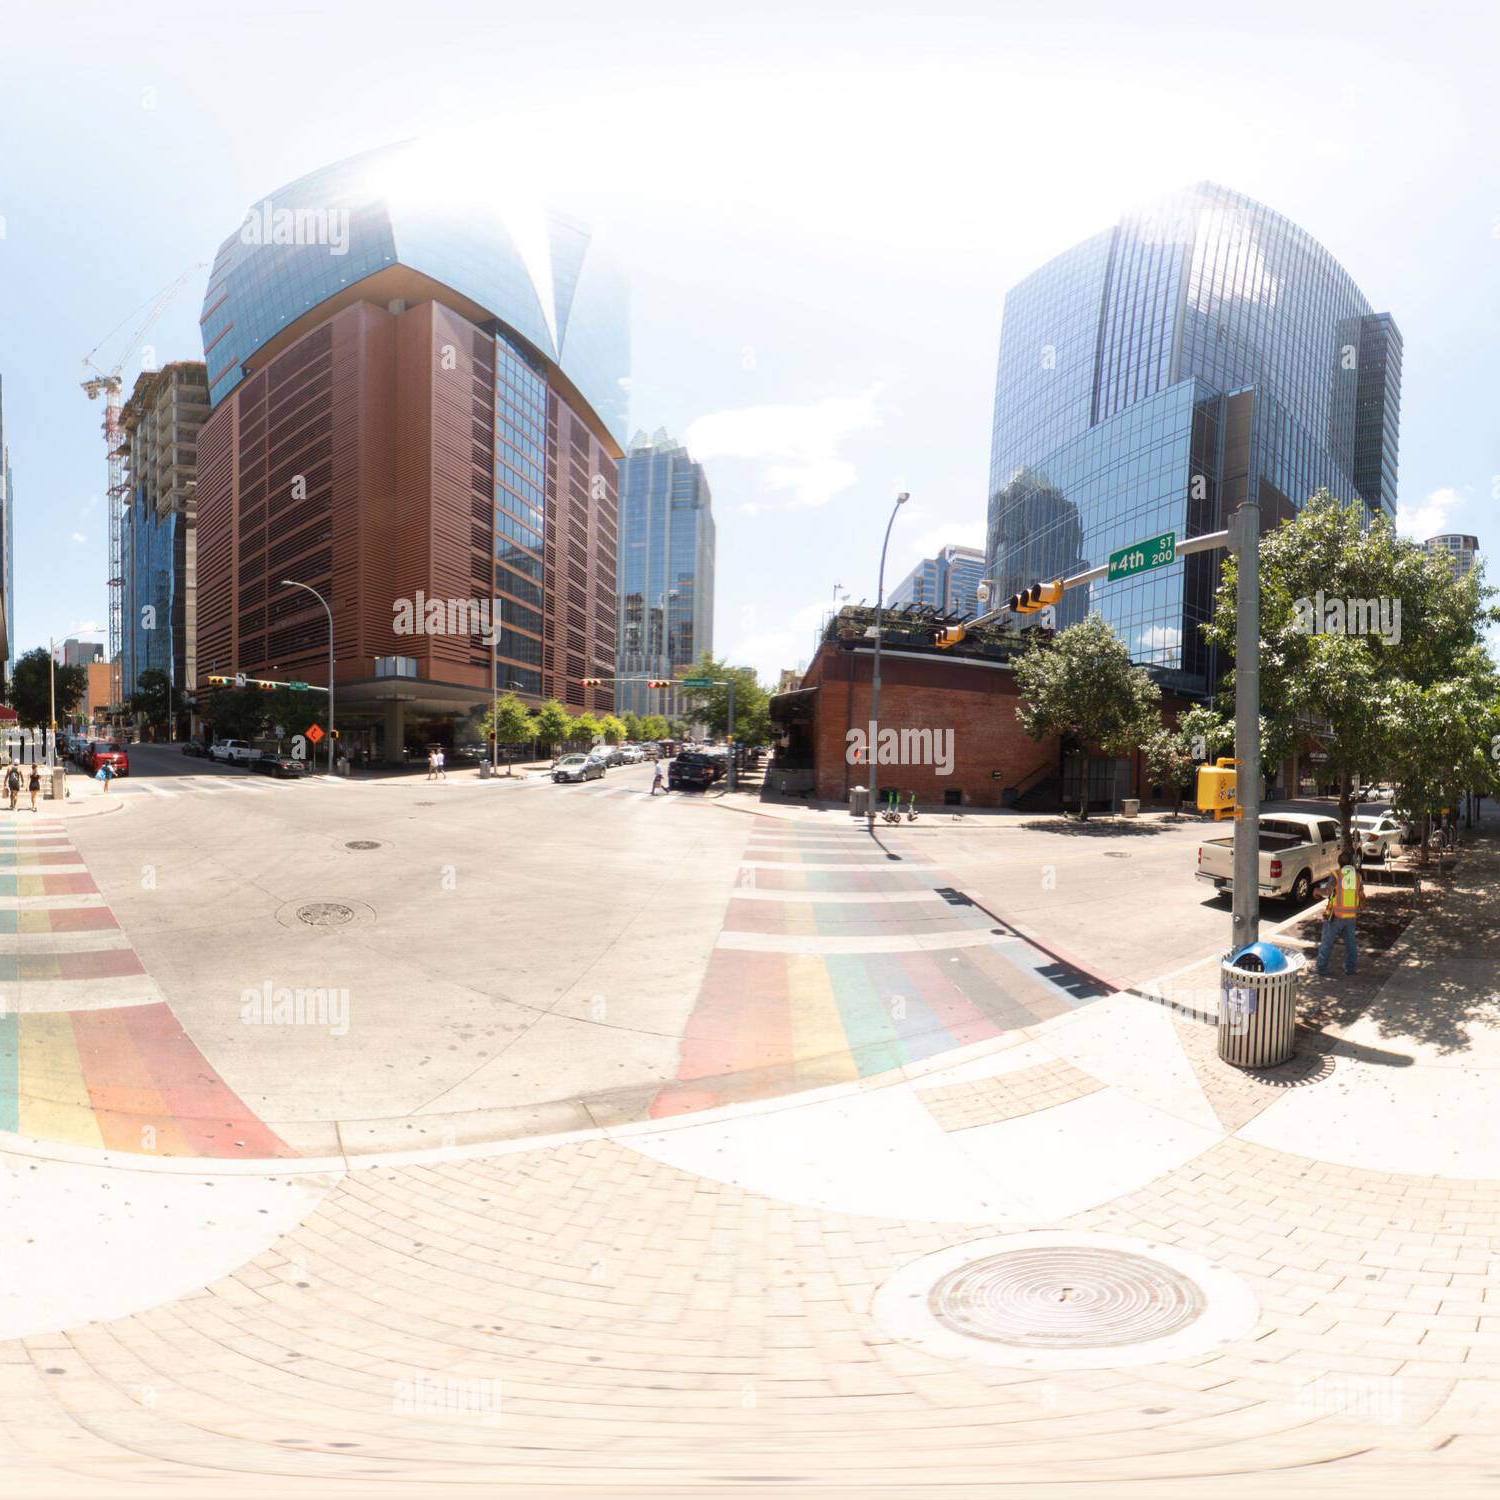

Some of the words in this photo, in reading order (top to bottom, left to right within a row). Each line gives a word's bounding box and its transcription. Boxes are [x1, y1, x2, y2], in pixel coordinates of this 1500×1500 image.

[1159, 536, 1173, 549] ST
[1110, 561, 1118, 573] W
[1118, 550, 1145, 571] 4th
[1151, 550, 1173, 565] 200
